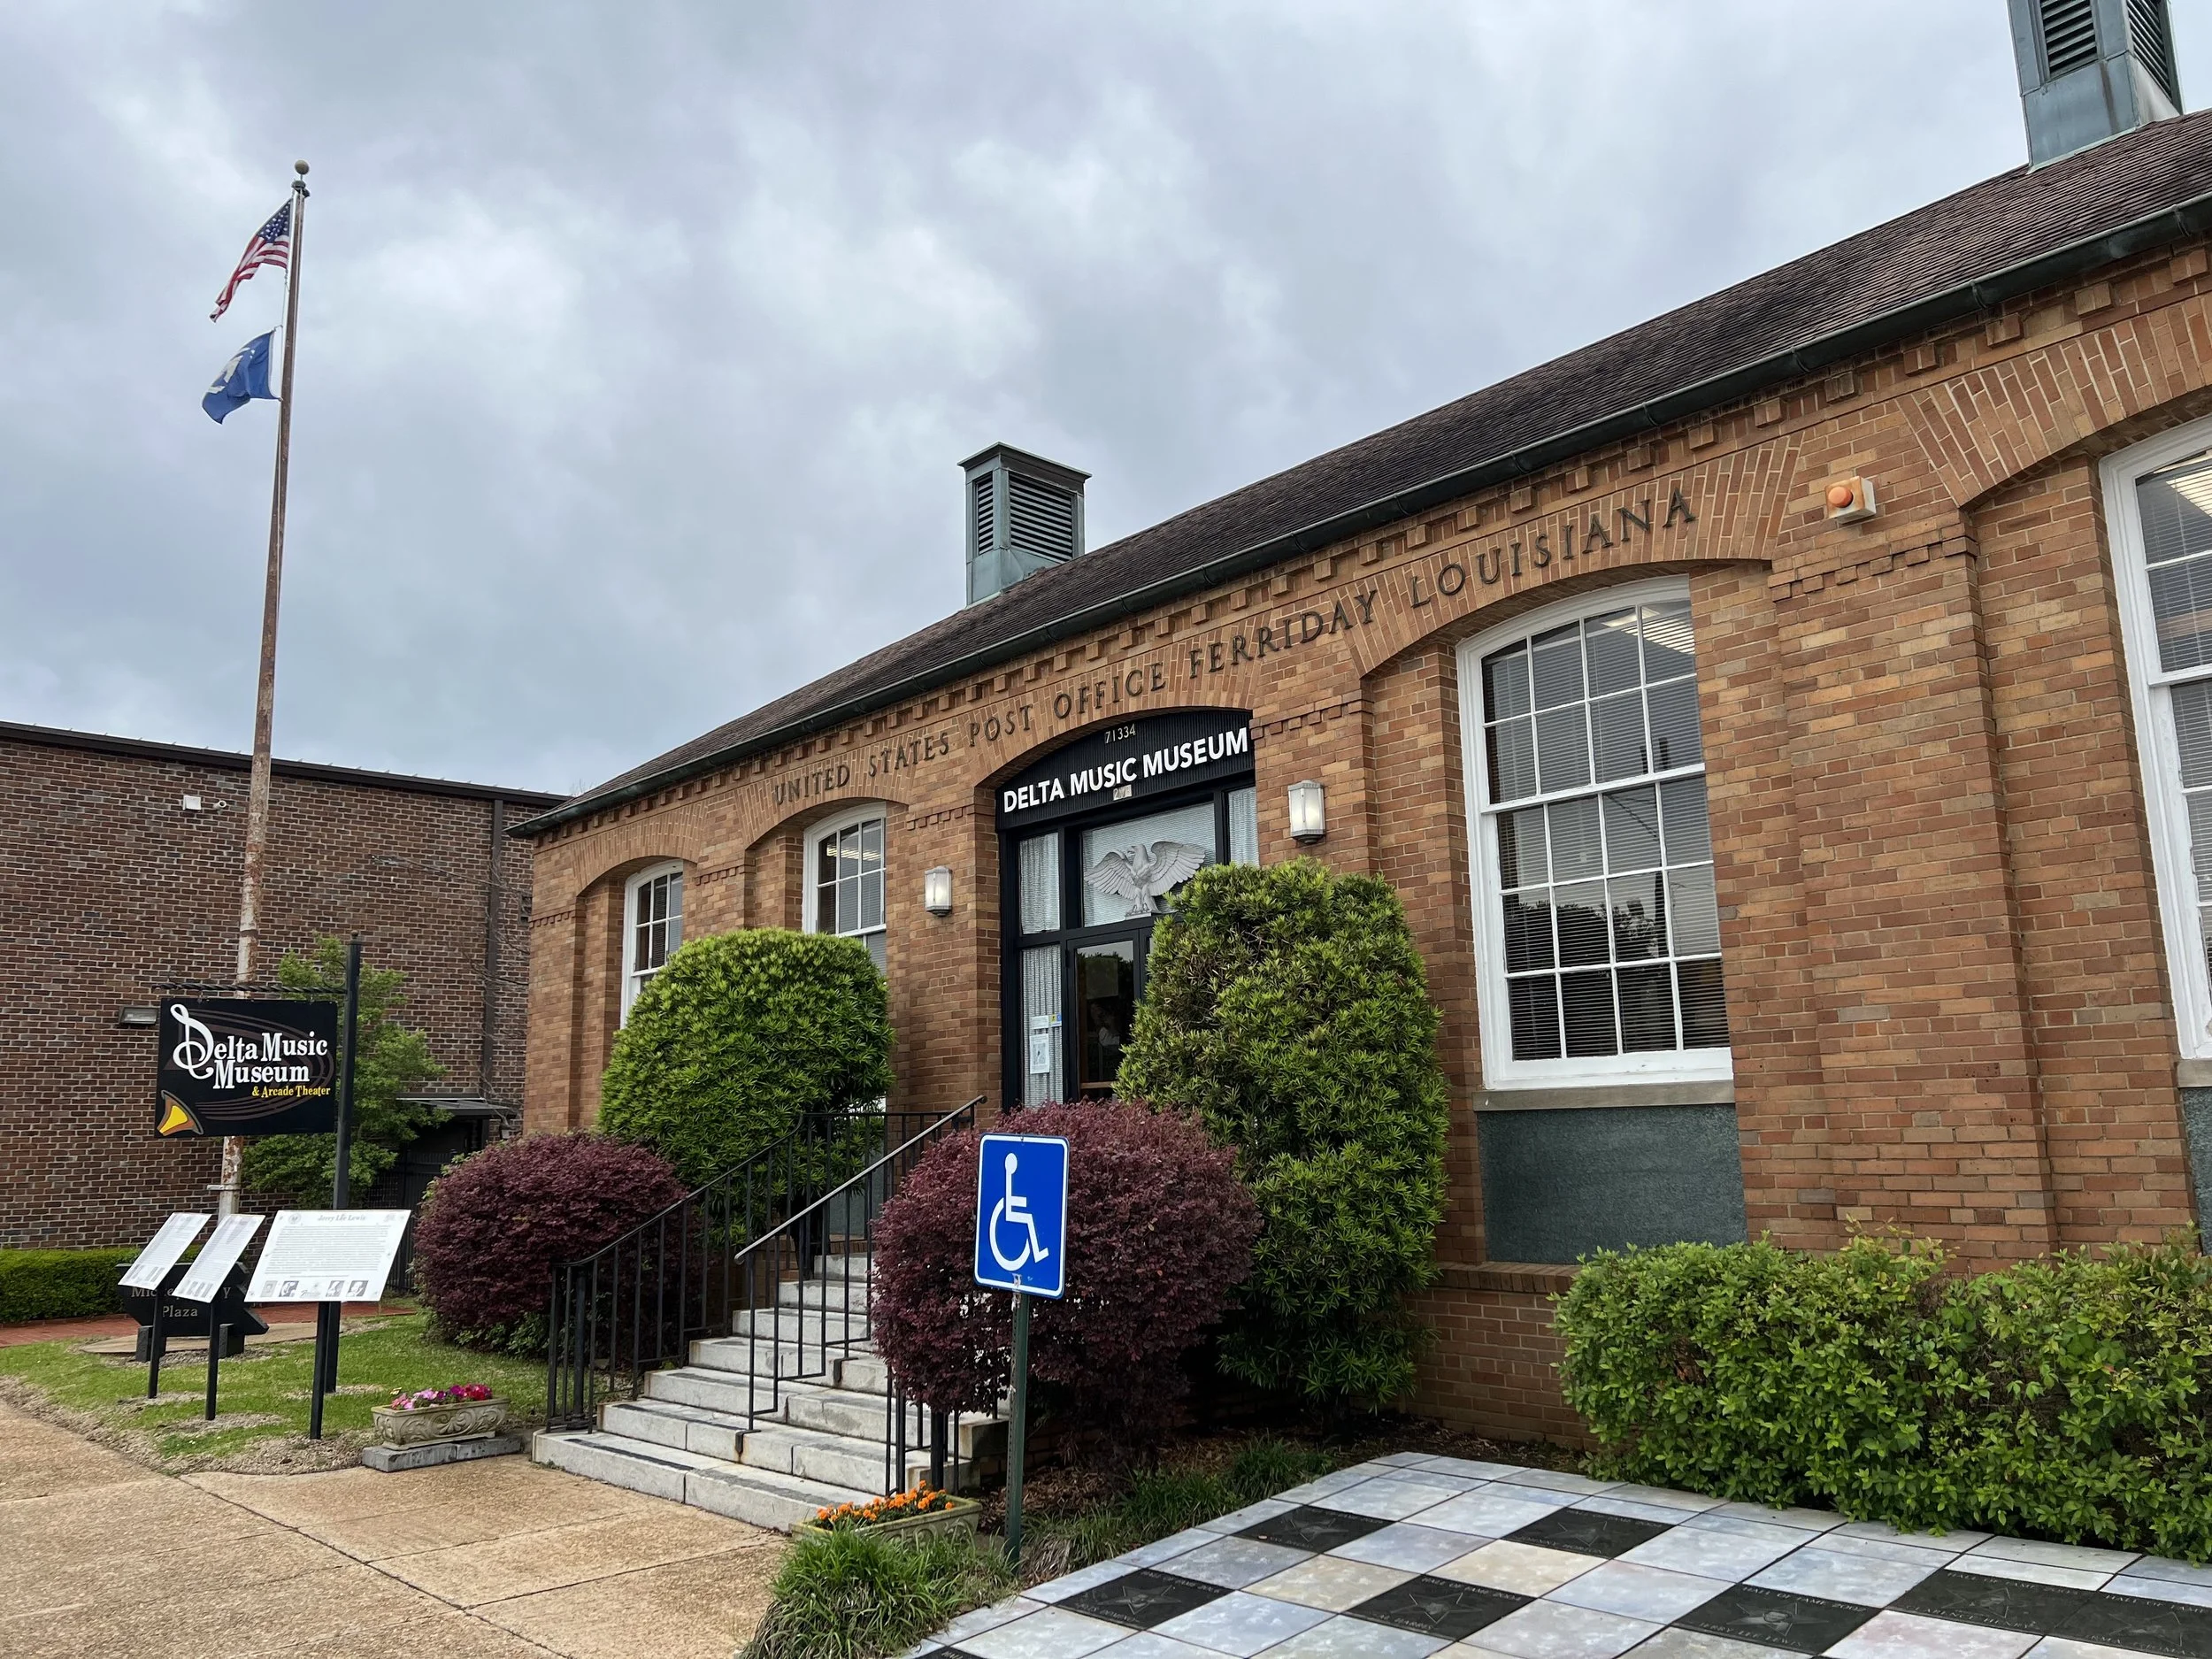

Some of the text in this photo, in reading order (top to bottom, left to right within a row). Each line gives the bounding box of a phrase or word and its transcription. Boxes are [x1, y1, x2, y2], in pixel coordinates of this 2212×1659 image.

[775, 488, 1695, 805] UNITED STATES POST OFFICE FERRIDAY LOUISIANA
[1105, 724, 1136, 743] 71334
[1003, 727, 1248, 813] DELTA MUSIC MUSEUM
[170, 1003, 328, 1079] Delta Music
[213, 1059, 310, 1089] Museum
[251, 1085, 331, 1098] & Arcade Theater
[163, 1305, 198, 1317] Plaza
